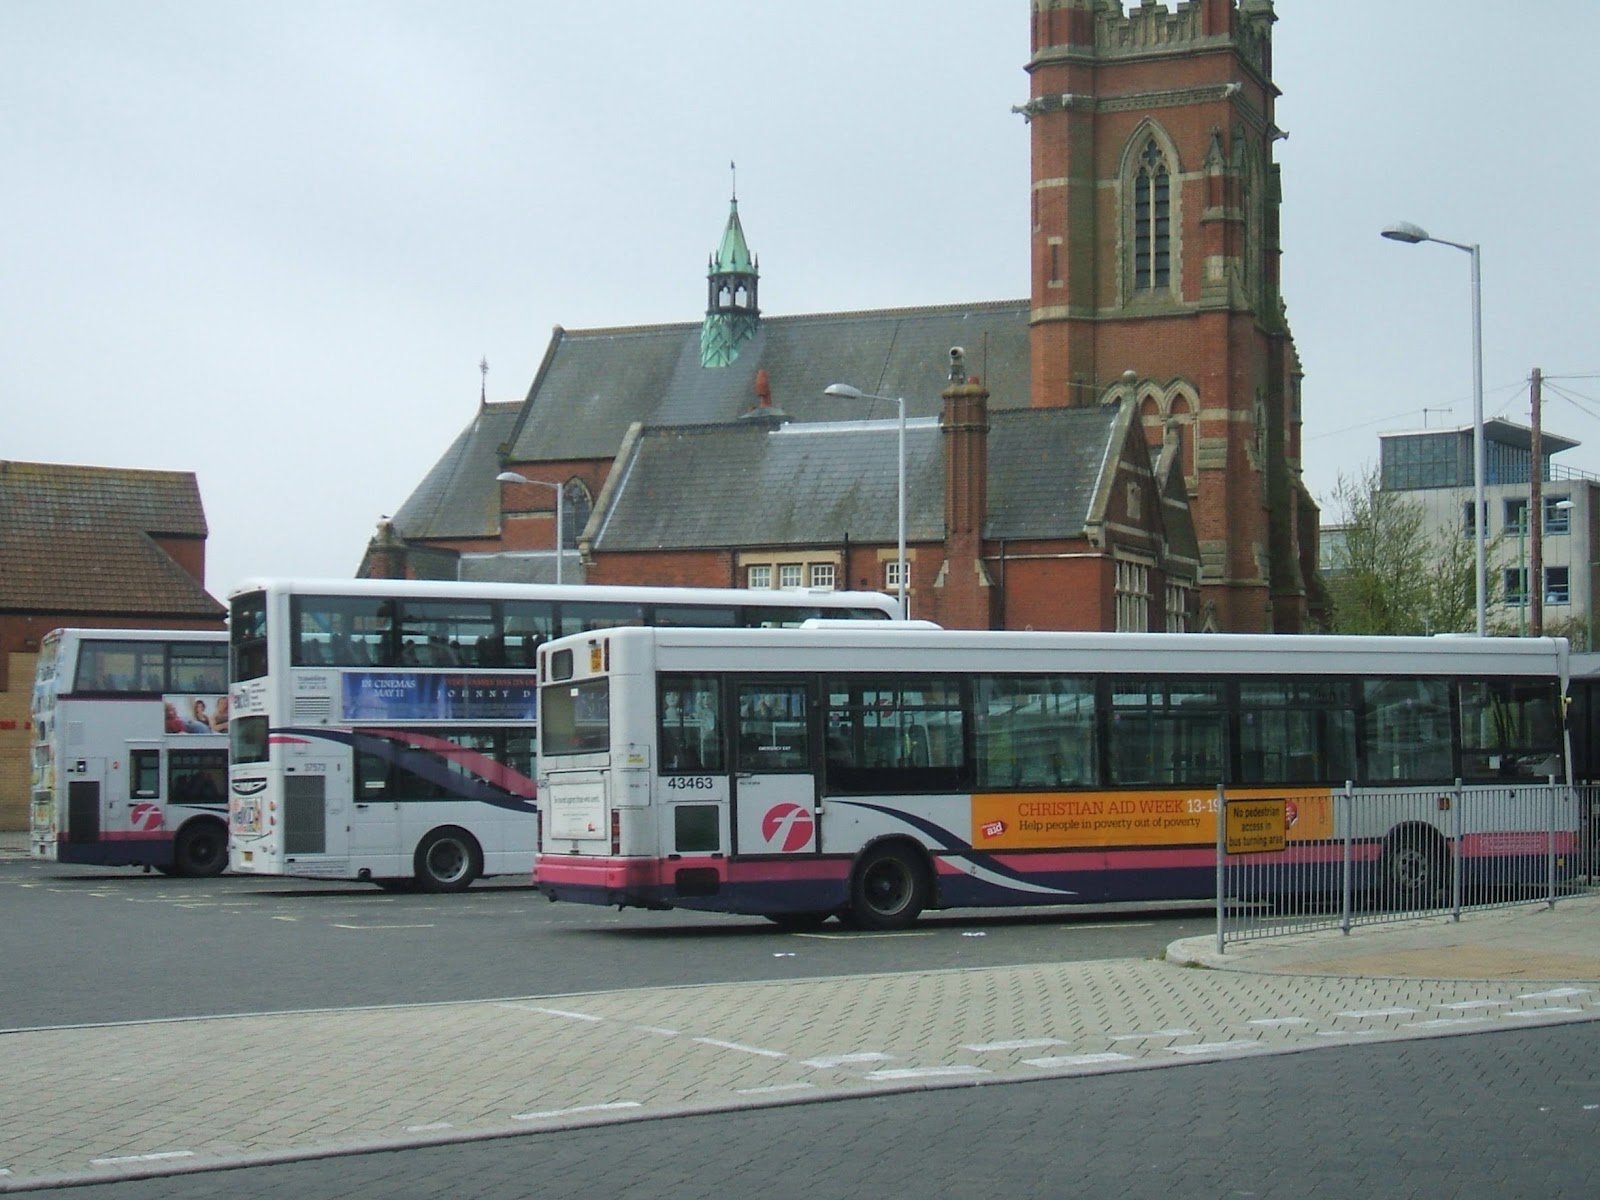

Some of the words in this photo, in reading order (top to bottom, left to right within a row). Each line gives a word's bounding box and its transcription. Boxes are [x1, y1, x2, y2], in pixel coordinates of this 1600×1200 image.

[361, 679, 372, 688] IN
[373, 679, 416, 689] CINEMAS
[374, 688, 395, 697] MAY
[668, 777, 713, 790] 43463
[1018, 801, 1104, 817] CHRISTIAN
[1108, 800, 1136, 815] AID
[1139, 799, 1184, 814] WEEK
[1233, 807, 1244, 818] No
[1245, 806, 1280, 818] pedestrian
[1019, 820, 1043, 832] Help
[1045, 819, 1080, 832] people
[1082, 819, 1092, 829] in
[1094, 818, 1132, 830] poverty
[1134, 818, 1150, 828] out
[1152, 817, 1162, 828] of
[1163, 817, 1201, 829] poverty
[1241, 823, 1264, 832] access
[1264, 822, 1272, 830] in
[1228, 836, 1242, 847] bus
[1243, 835, 1268, 847] turning
[1269, 835, 1283, 845] area
